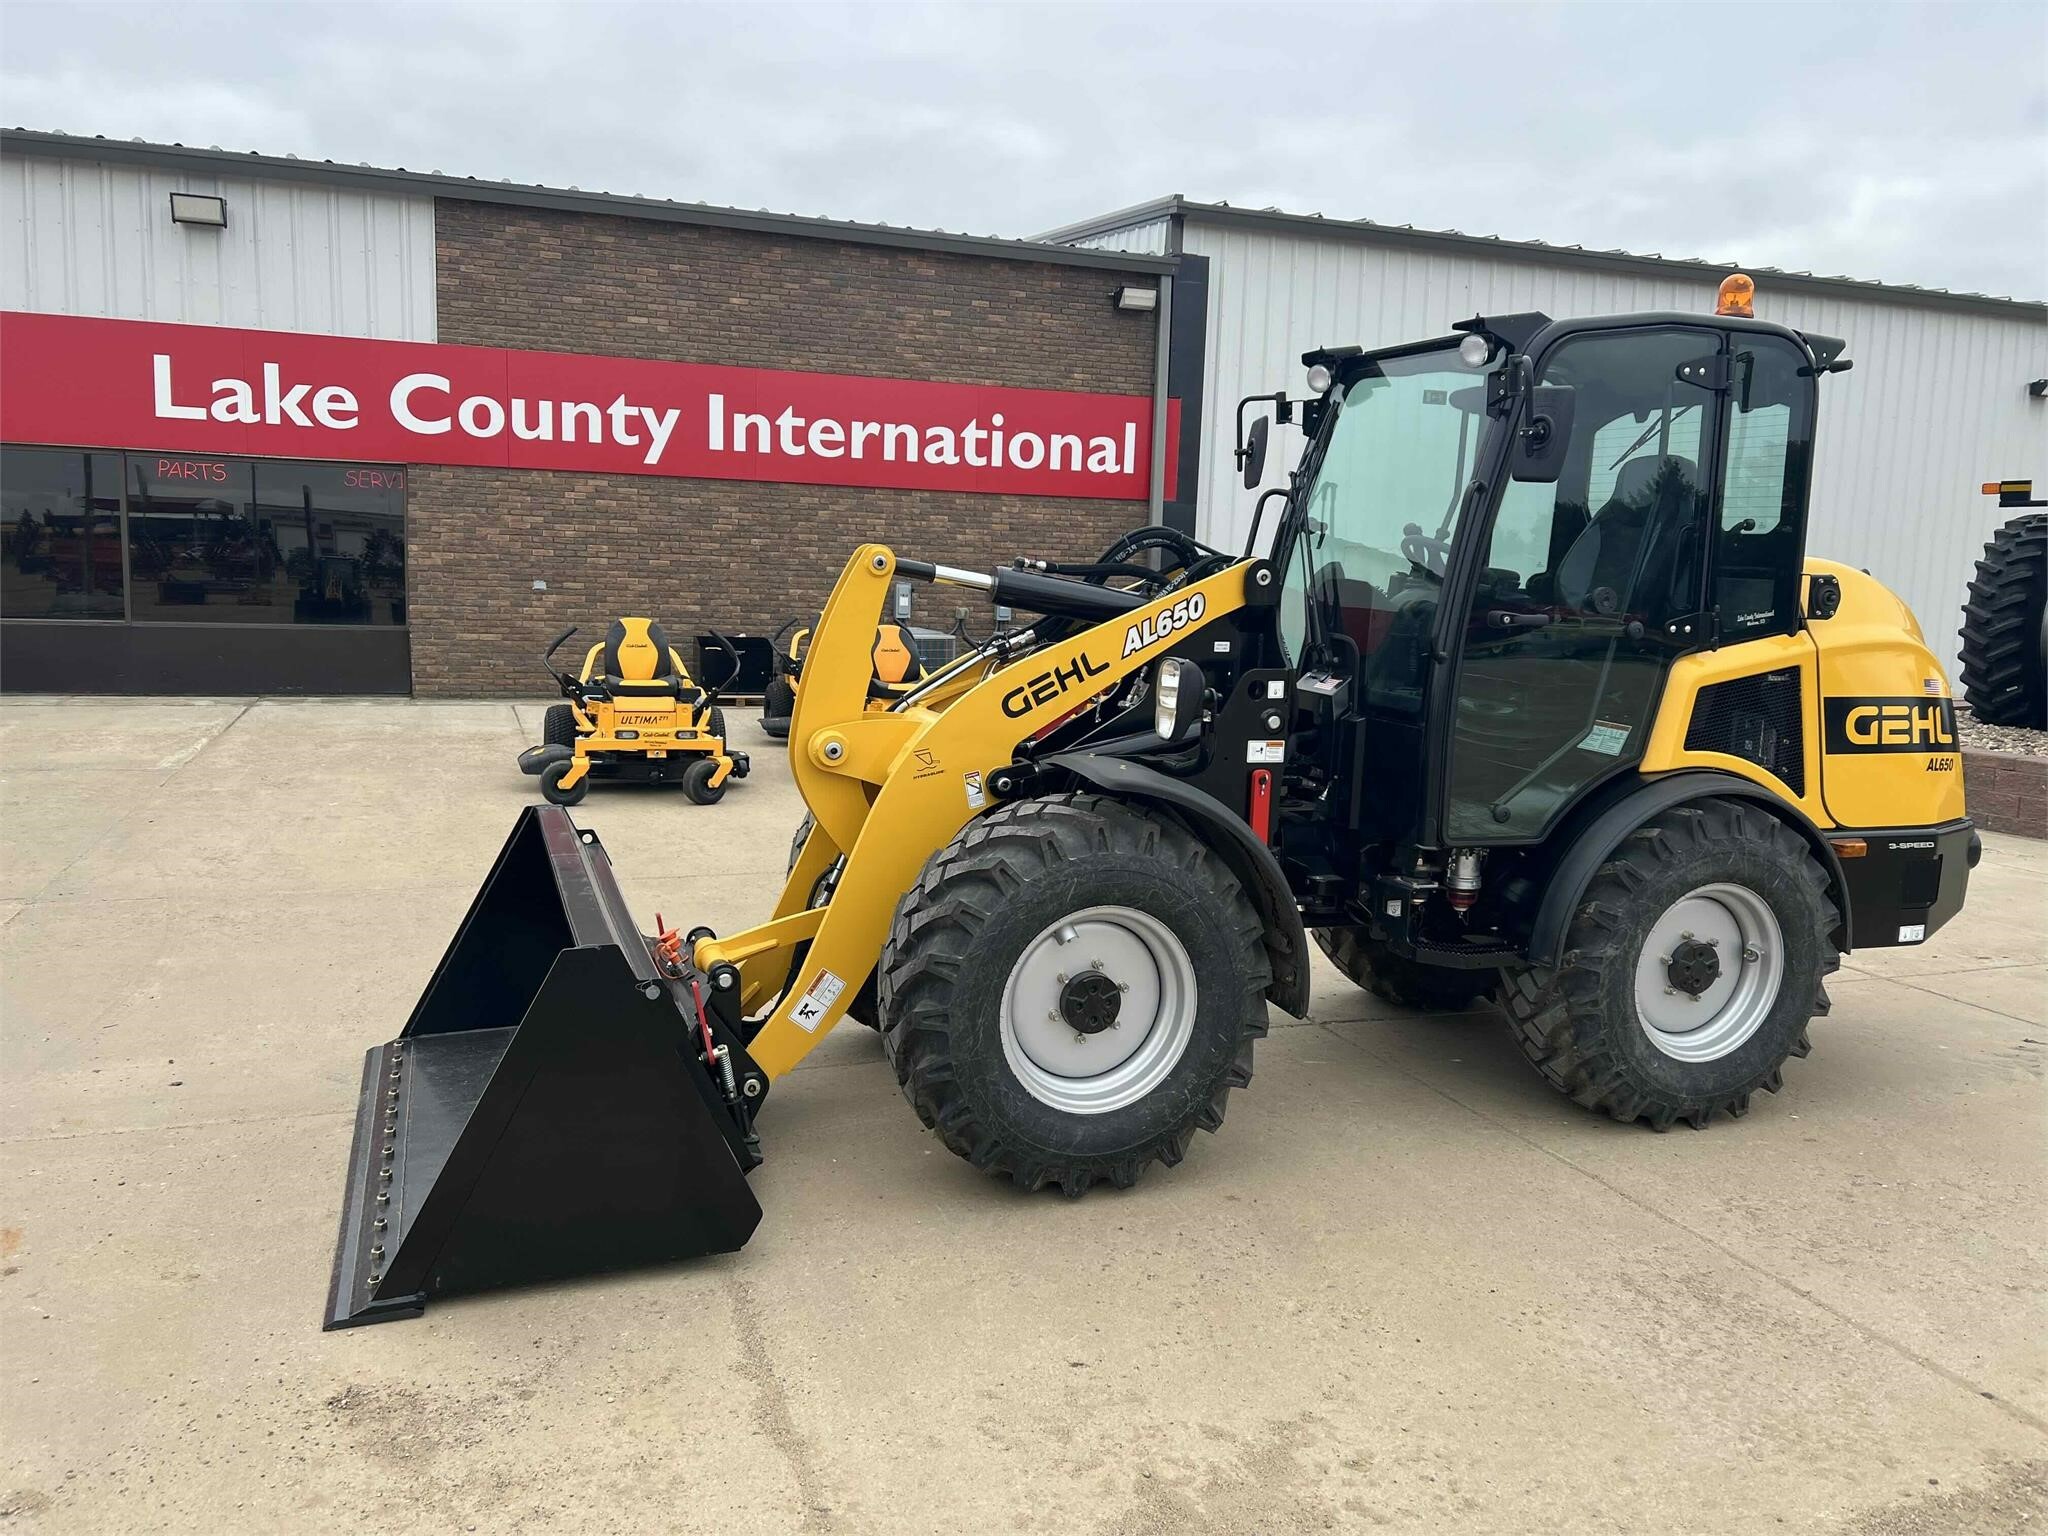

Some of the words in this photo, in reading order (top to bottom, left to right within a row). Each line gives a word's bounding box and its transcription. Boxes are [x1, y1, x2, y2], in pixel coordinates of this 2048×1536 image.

[153, 354, 359, 430] Lake
[390, 373, 681, 465] County
[709, 393, 1137, 475] International
[157, 459, 228, 482] PARTS
[1121, 592, 1206, 660] AL650
[1001, 652, 1110, 719] GEHL
[620, 715, 658, 725] ULTIMA
[1845, 705, 1953, 745] GEHL
[1926, 758, 1954, 772] AL650
[1888, 841, 1935, 850] 3-SPEED
